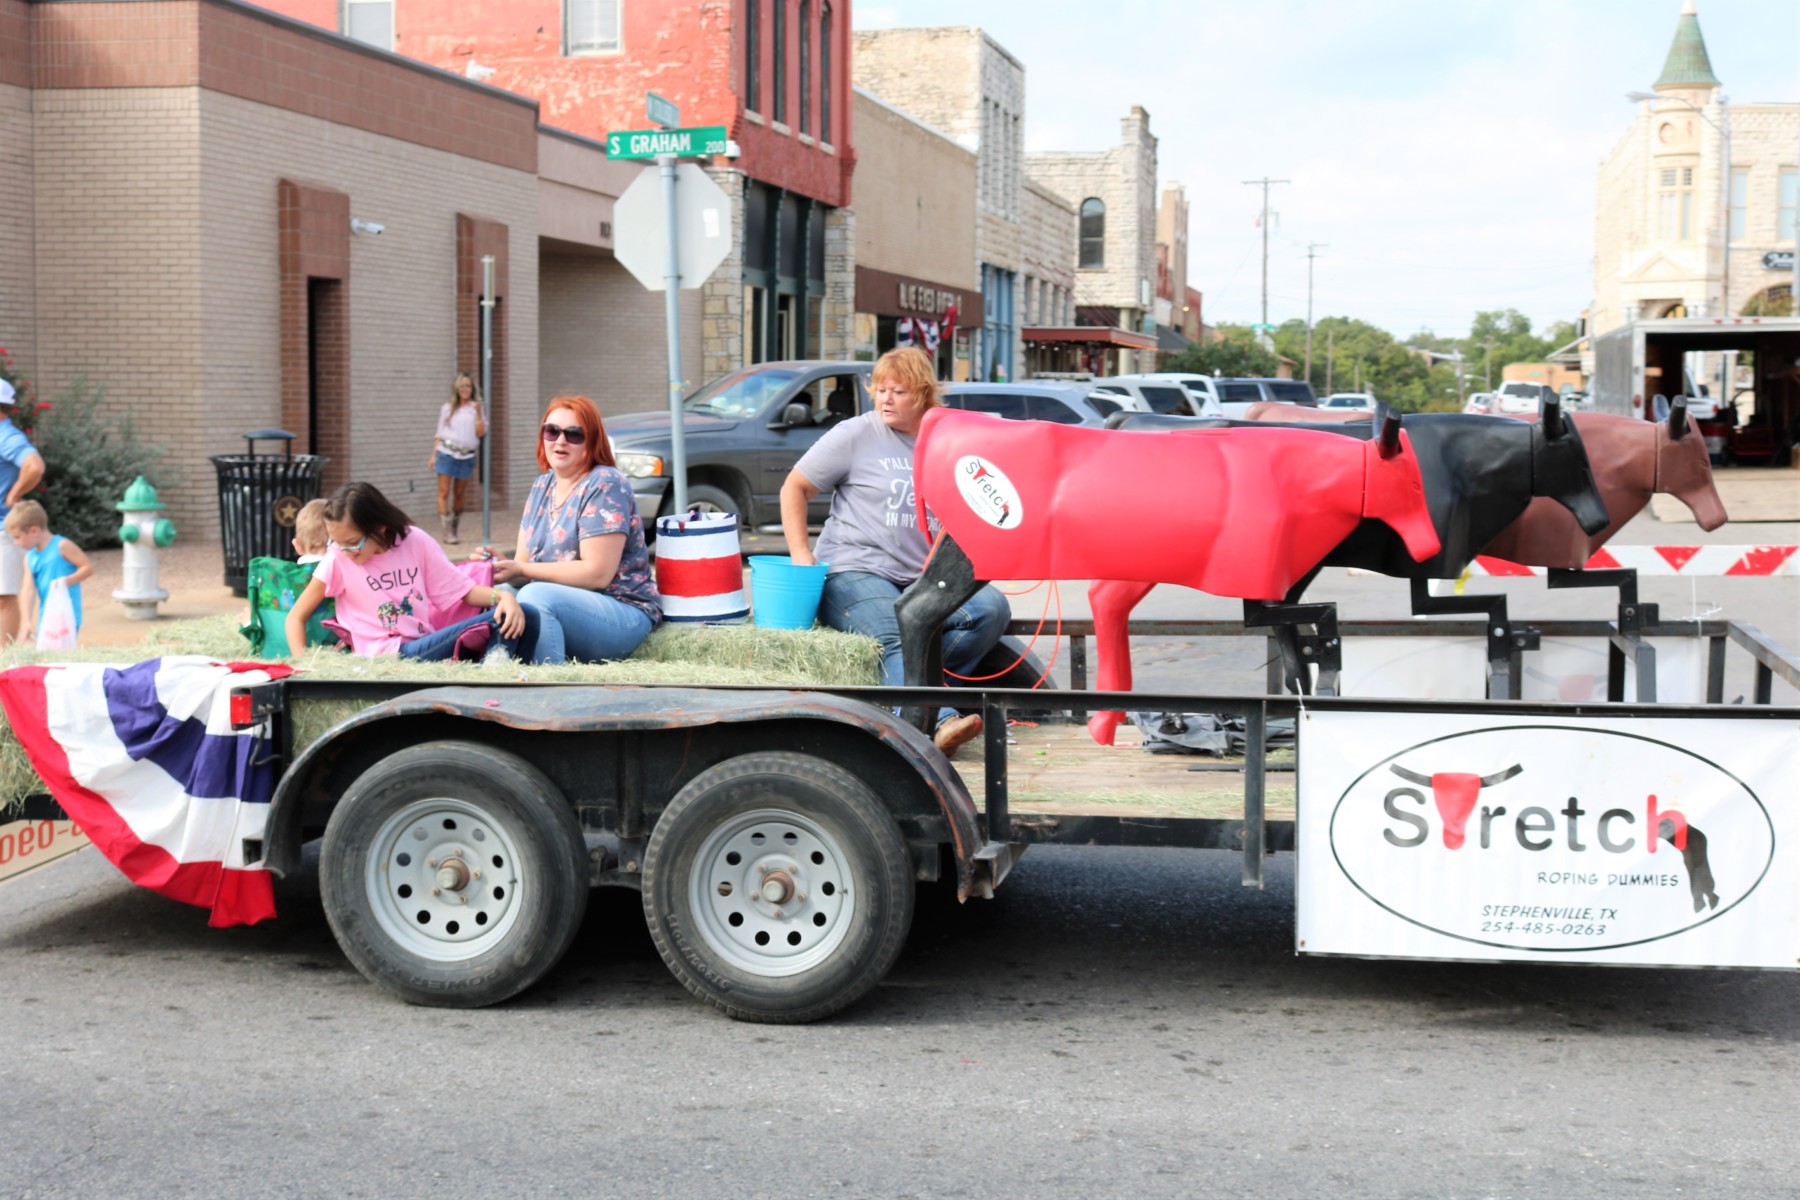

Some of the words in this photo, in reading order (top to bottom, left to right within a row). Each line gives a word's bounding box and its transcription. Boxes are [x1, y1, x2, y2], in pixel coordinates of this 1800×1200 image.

[610, 136, 621, 155] S
[630, 133, 691, 154] GRAHAM
[705, 140, 724, 154] 200
[879, 457, 914, 471] Y'ALL
[886, 512, 898, 527] IN
[901, 513, 917, 529] MY
[1538, 871, 1599, 885] ROPING
[1608, 873, 1679, 887] DUMMIES
[1481, 904, 1595, 921] STEPHENVILLE,
[1599, 908, 1618, 921] TX
[1481, 921, 1607, 936] 254-485-0263
